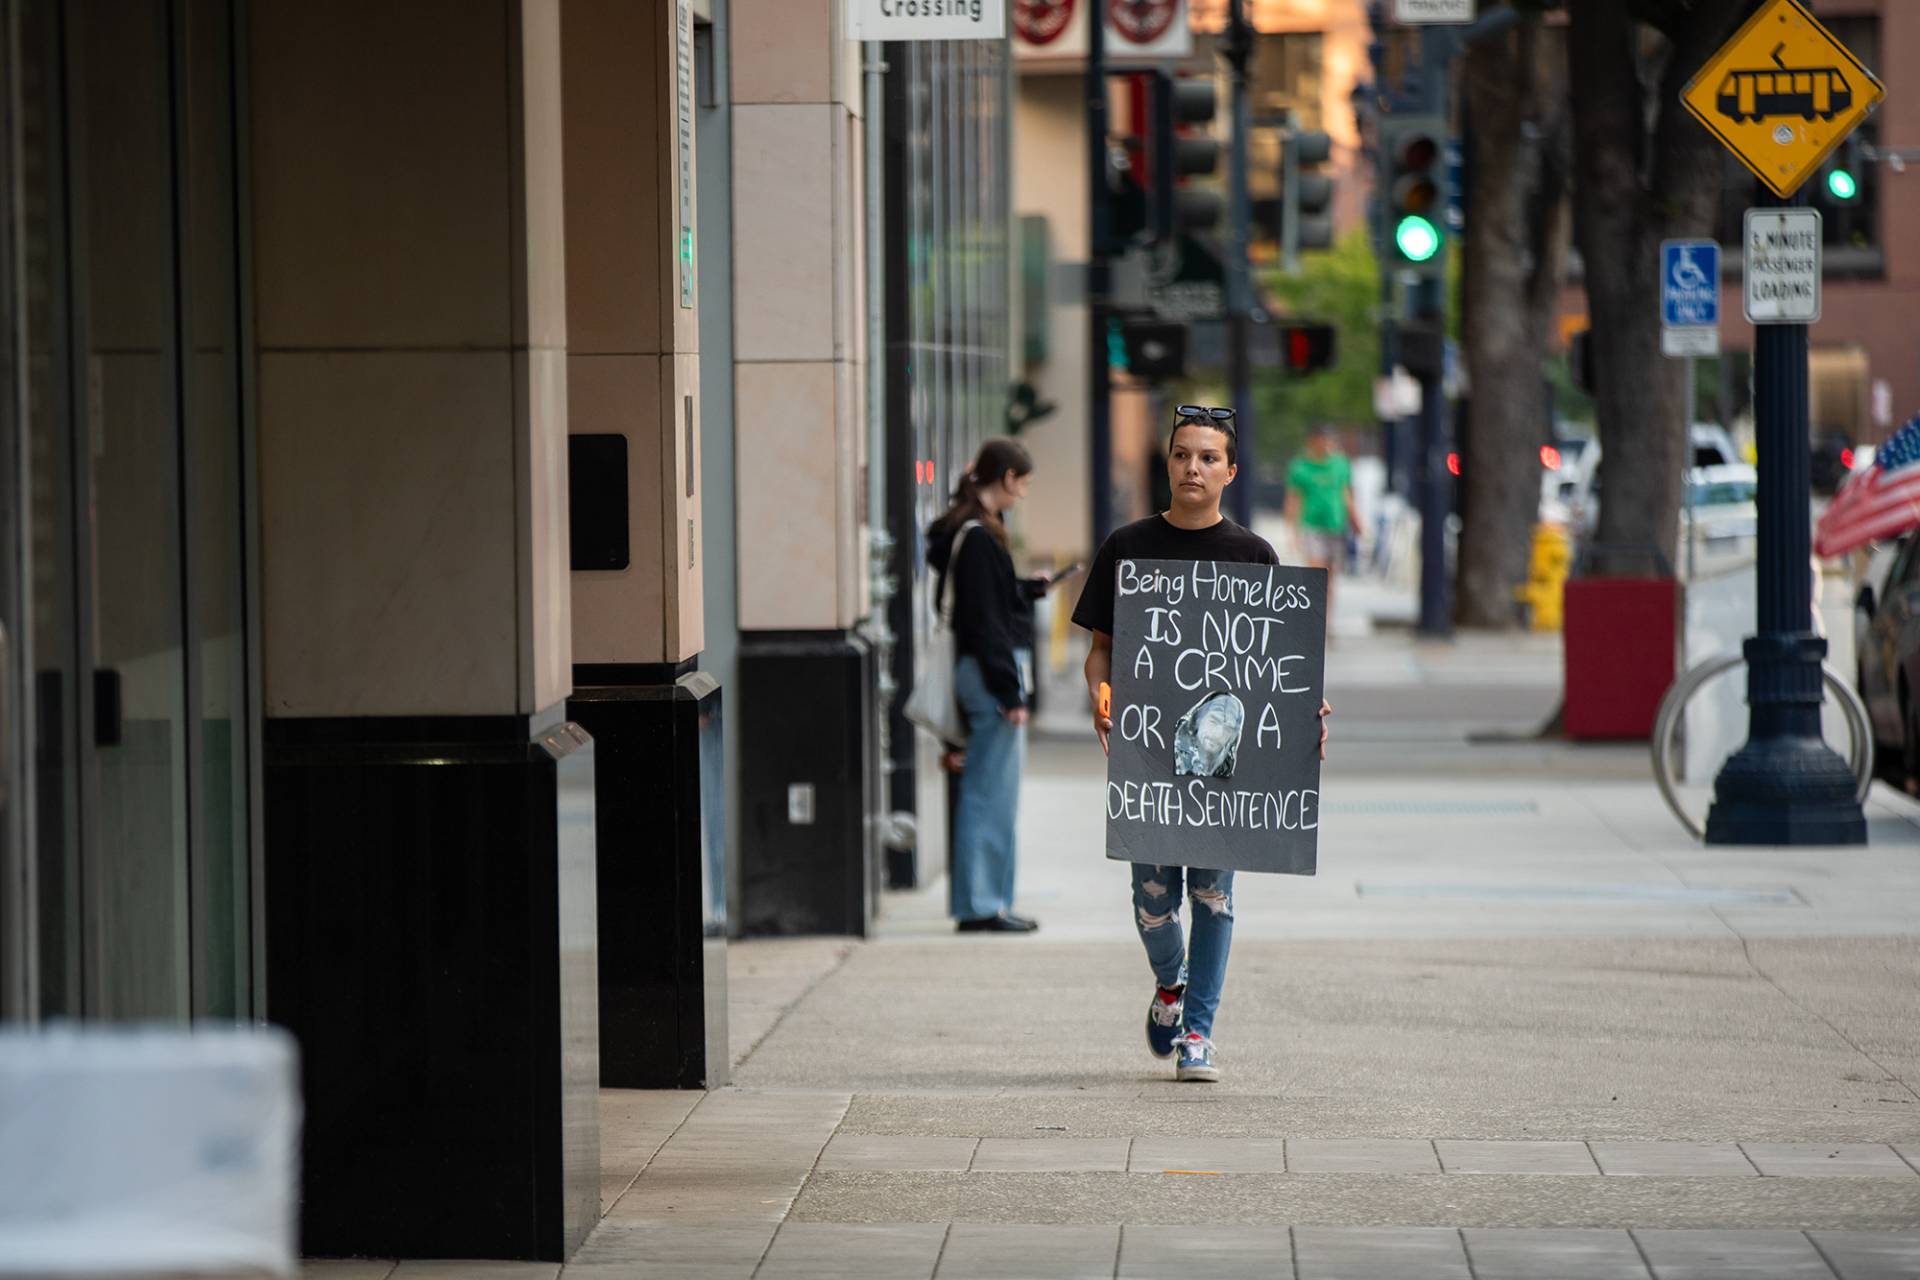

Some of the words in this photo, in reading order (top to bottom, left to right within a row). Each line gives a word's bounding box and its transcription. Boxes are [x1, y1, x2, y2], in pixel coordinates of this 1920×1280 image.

[880, 0, 982, 22] Crossing
[1766, 232, 1815, 249] MINUTE
[1752, 257, 1814, 274] PASSENGER
[1752, 281, 1812, 301] LOADING
[1119, 560, 1184, 605] Being
[1192, 560, 1311, 612] Homeless
[1144, 607, 1182, 646] IS
[1202, 609, 1285, 656] NOT
[1134, 644, 1154, 679] A
[1174, 648, 1311, 693] CRIME
[1120, 704, 1166, 750] OR
[1256, 702, 1282, 749] A
[1107, 780, 1183, 826] DEATH
